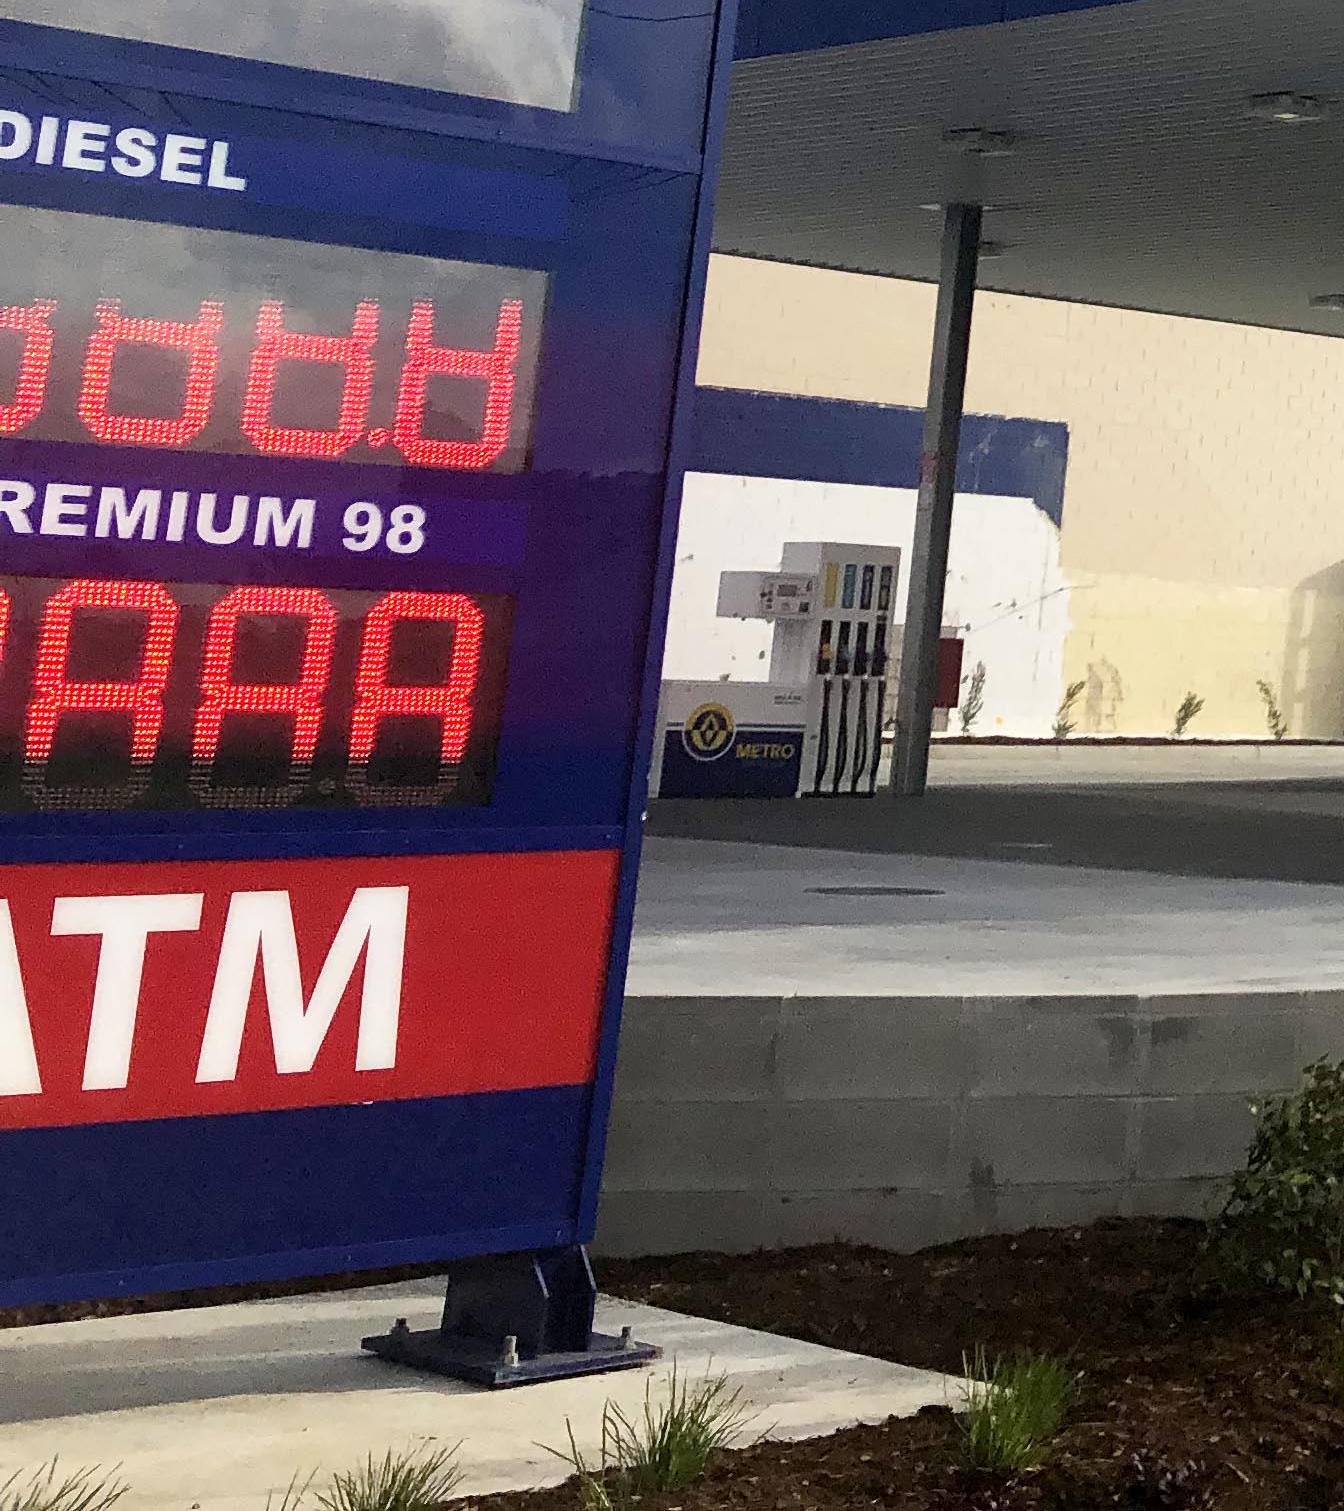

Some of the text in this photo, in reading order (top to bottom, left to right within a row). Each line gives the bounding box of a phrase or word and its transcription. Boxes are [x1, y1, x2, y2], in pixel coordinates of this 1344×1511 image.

[0, 109, 247, 191] DIESEL
[0, 478, 428, 554] REMIUM 98
[735, 743, 795, 760] METRO
